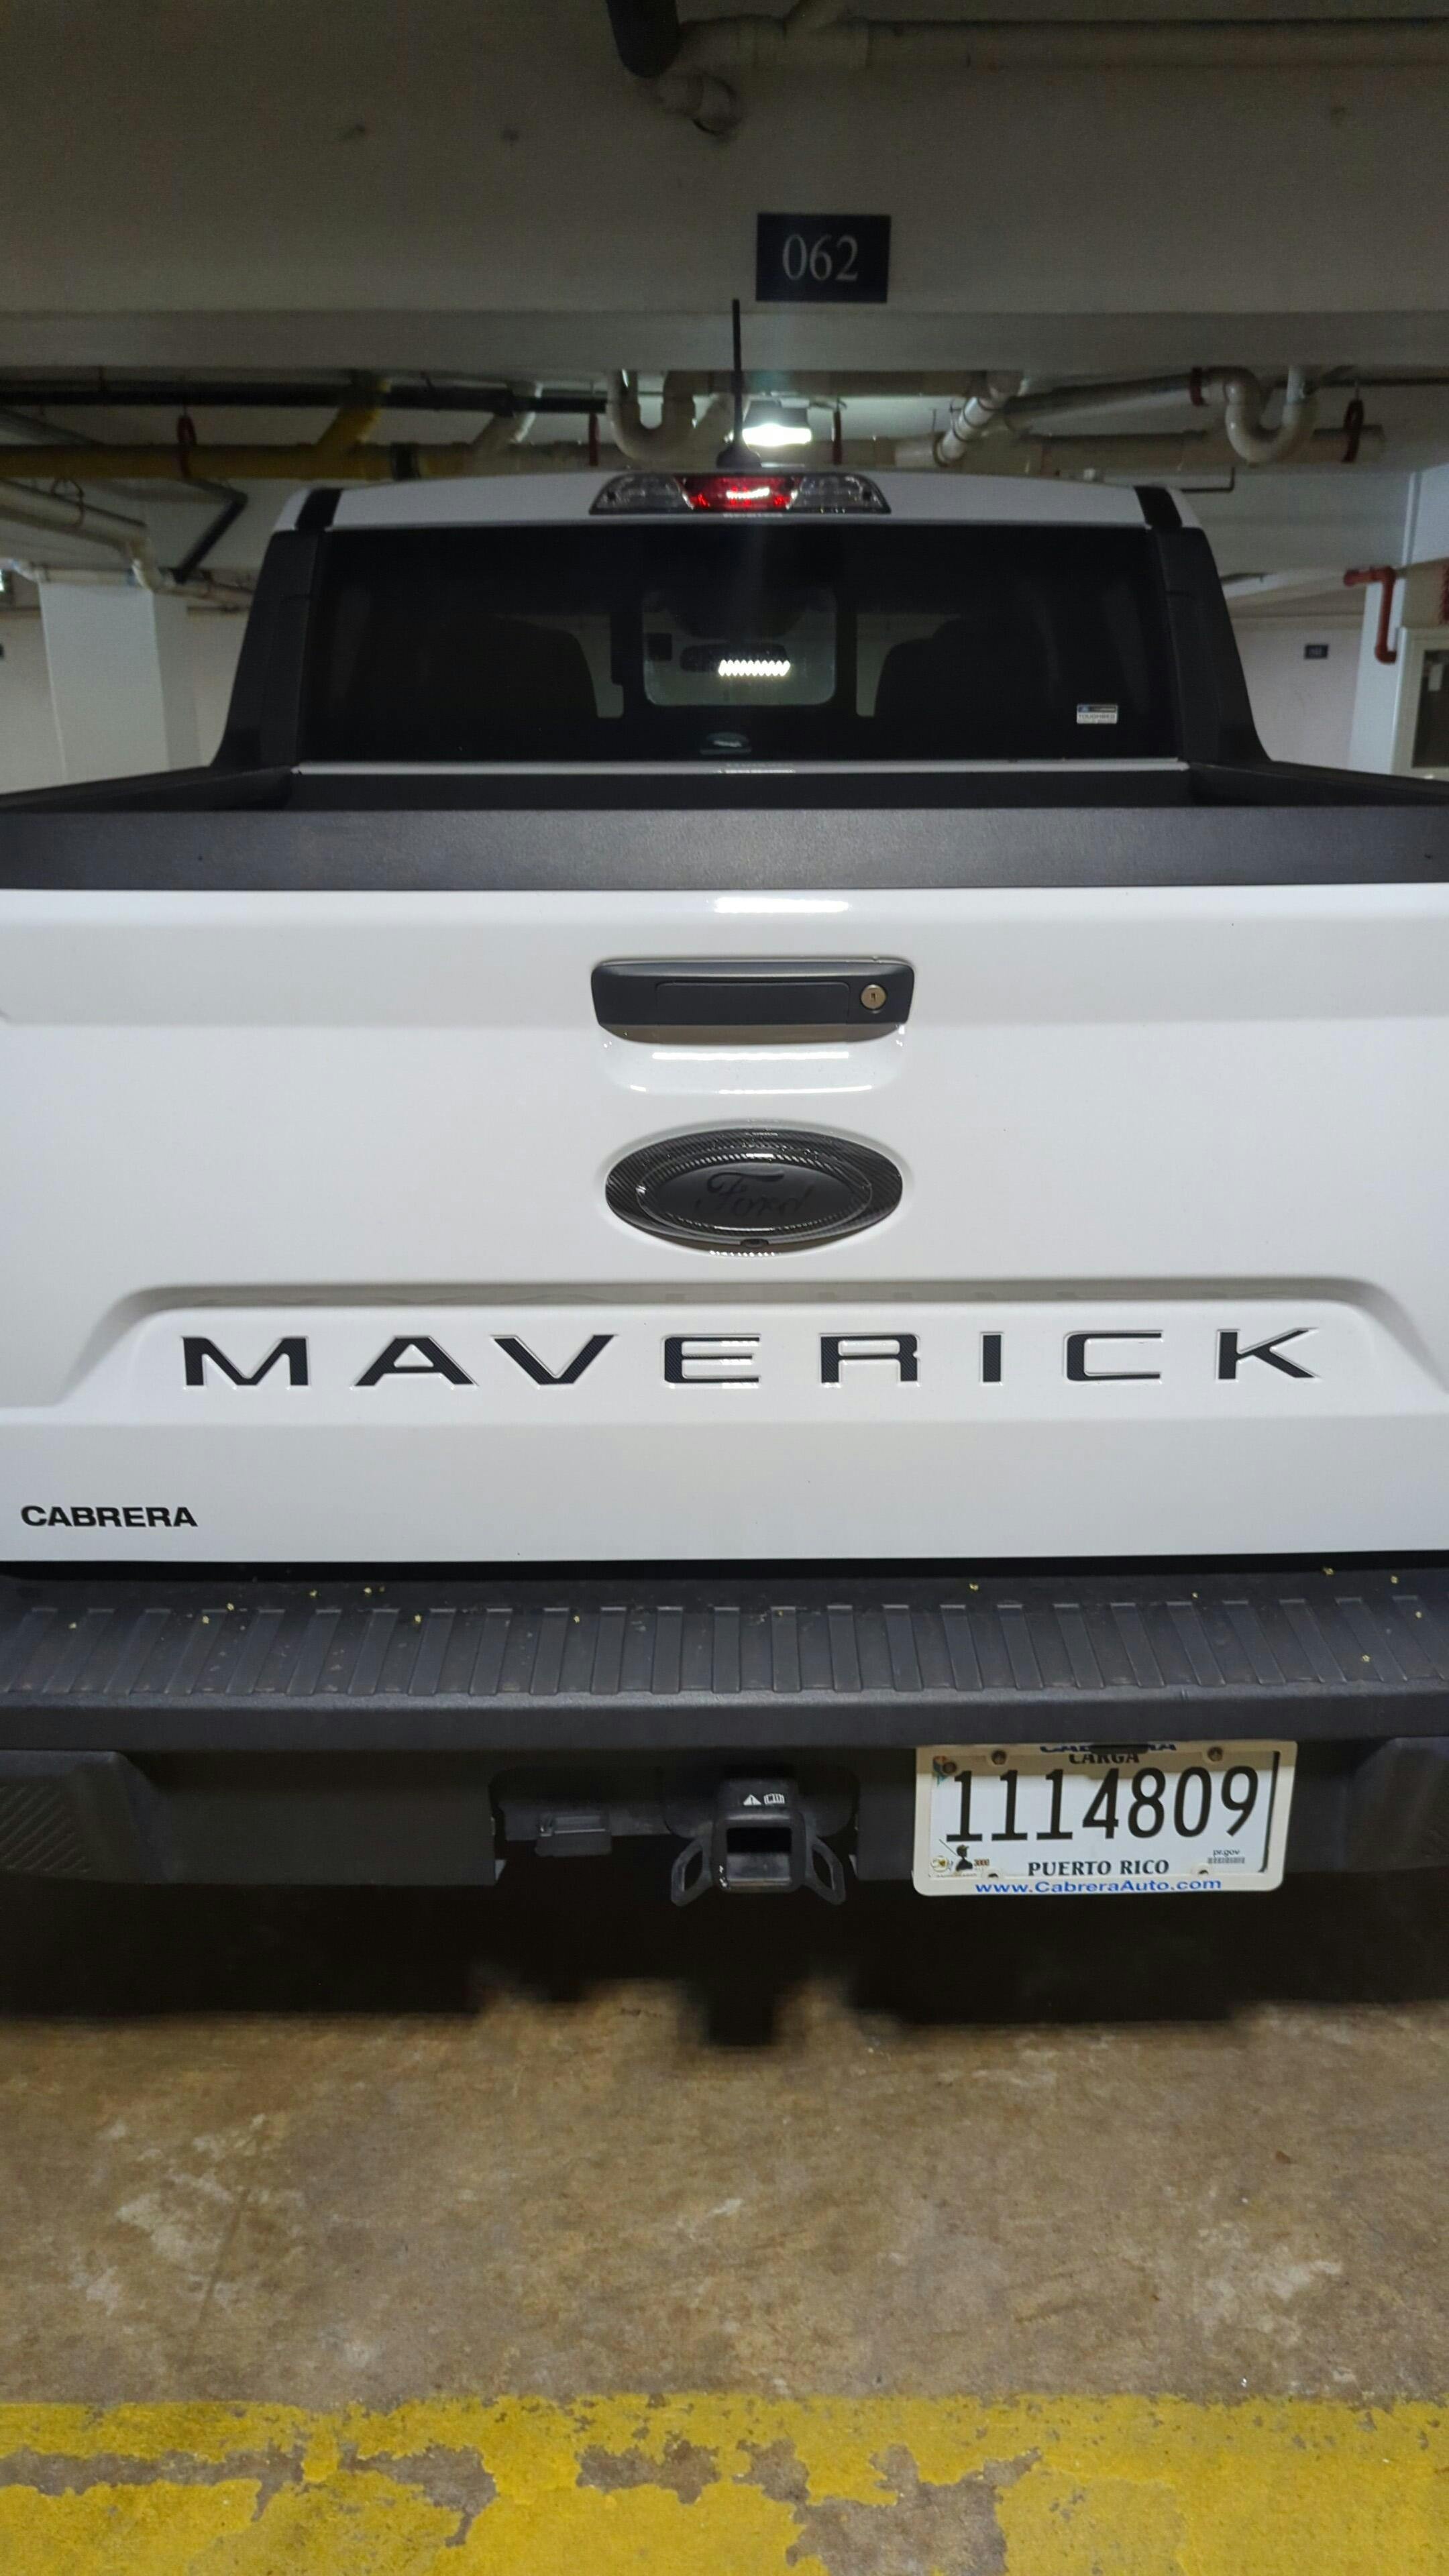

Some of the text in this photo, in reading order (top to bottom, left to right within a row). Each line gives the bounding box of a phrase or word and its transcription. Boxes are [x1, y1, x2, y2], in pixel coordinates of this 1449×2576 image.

[782, 235, 858, 280] 062
[694, 1171, 816, 1217] Ford
[182, 1330, 1318, 1386] MAVERICK
[21, 1505, 198, 1527] CABRERA
[1069, 1752, 1139, 1764] CARGA
[946, 1766, 1258, 1841] 1114809
[1028, 1860, 1169, 1876] PUERTO RICO
[975, 1880, 1222, 1892] www.CabreraAuto.com
